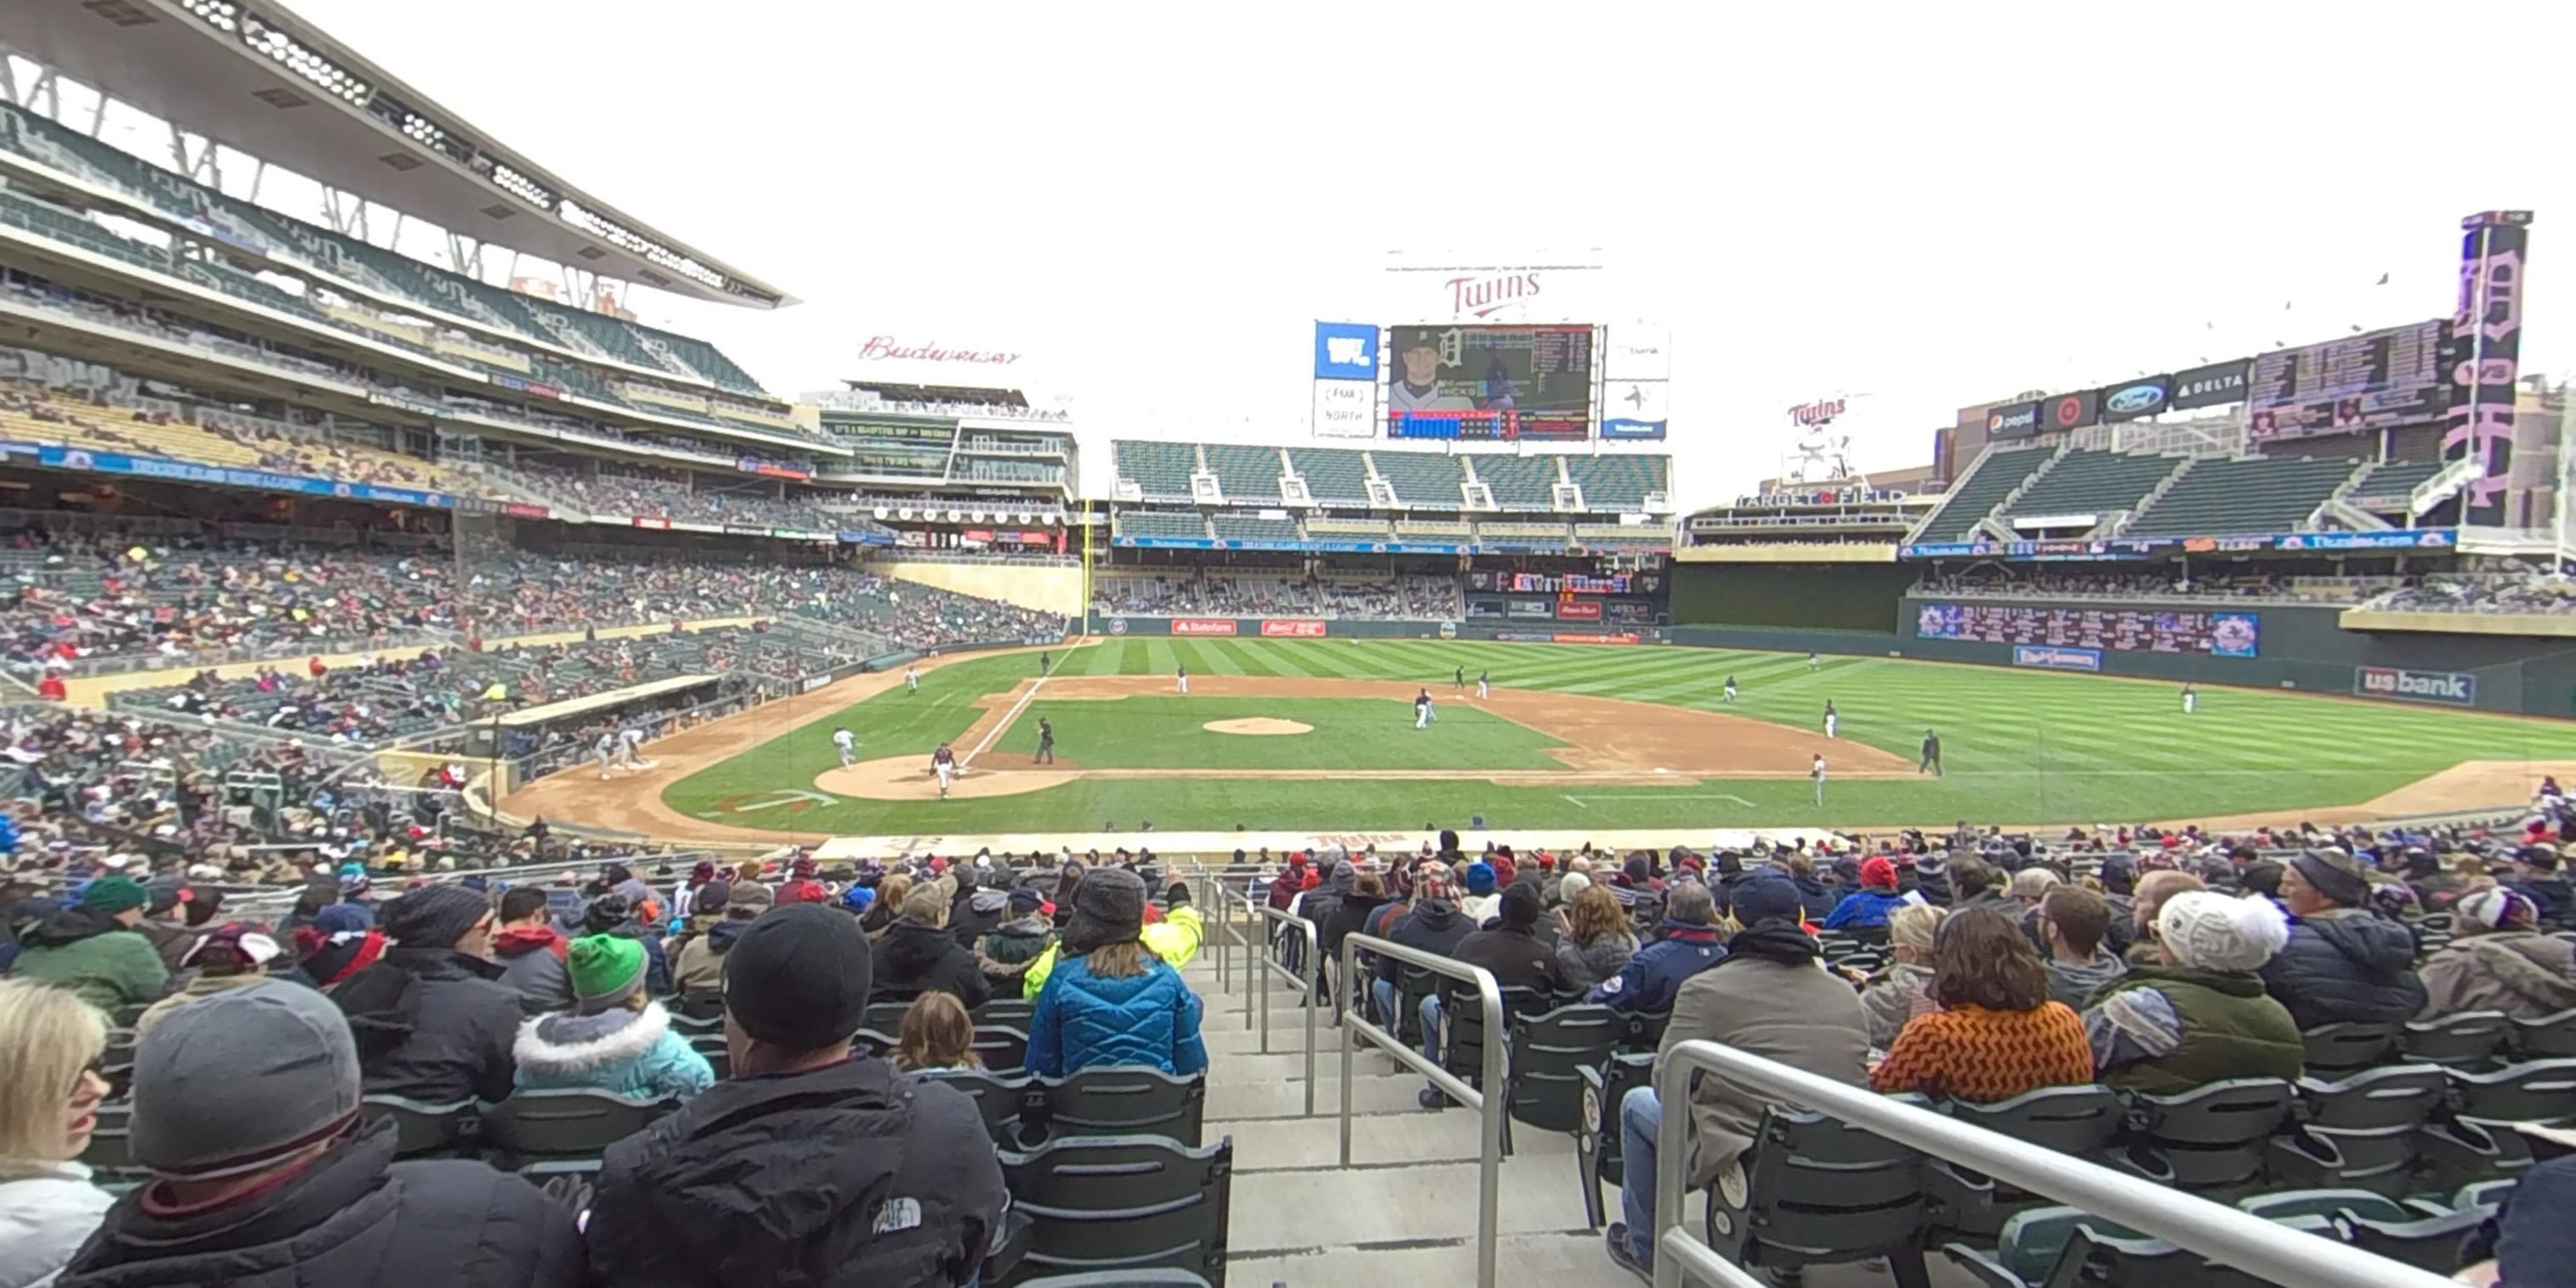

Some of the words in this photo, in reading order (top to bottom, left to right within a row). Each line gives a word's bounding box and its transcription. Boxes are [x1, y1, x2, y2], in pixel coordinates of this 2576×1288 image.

[1445, 272, 1541, 318] Twins
[858, 336, 1022, 364] Budweiser
[2194, 375, 2243, 393] DELTA
[1788, 399, 1846, 426] Twins
[2004, 411, 2035, 430] pepsi
[1736, 494, 1818, 508] TARGET
[1840, 489, 1907, 504] FIELD
